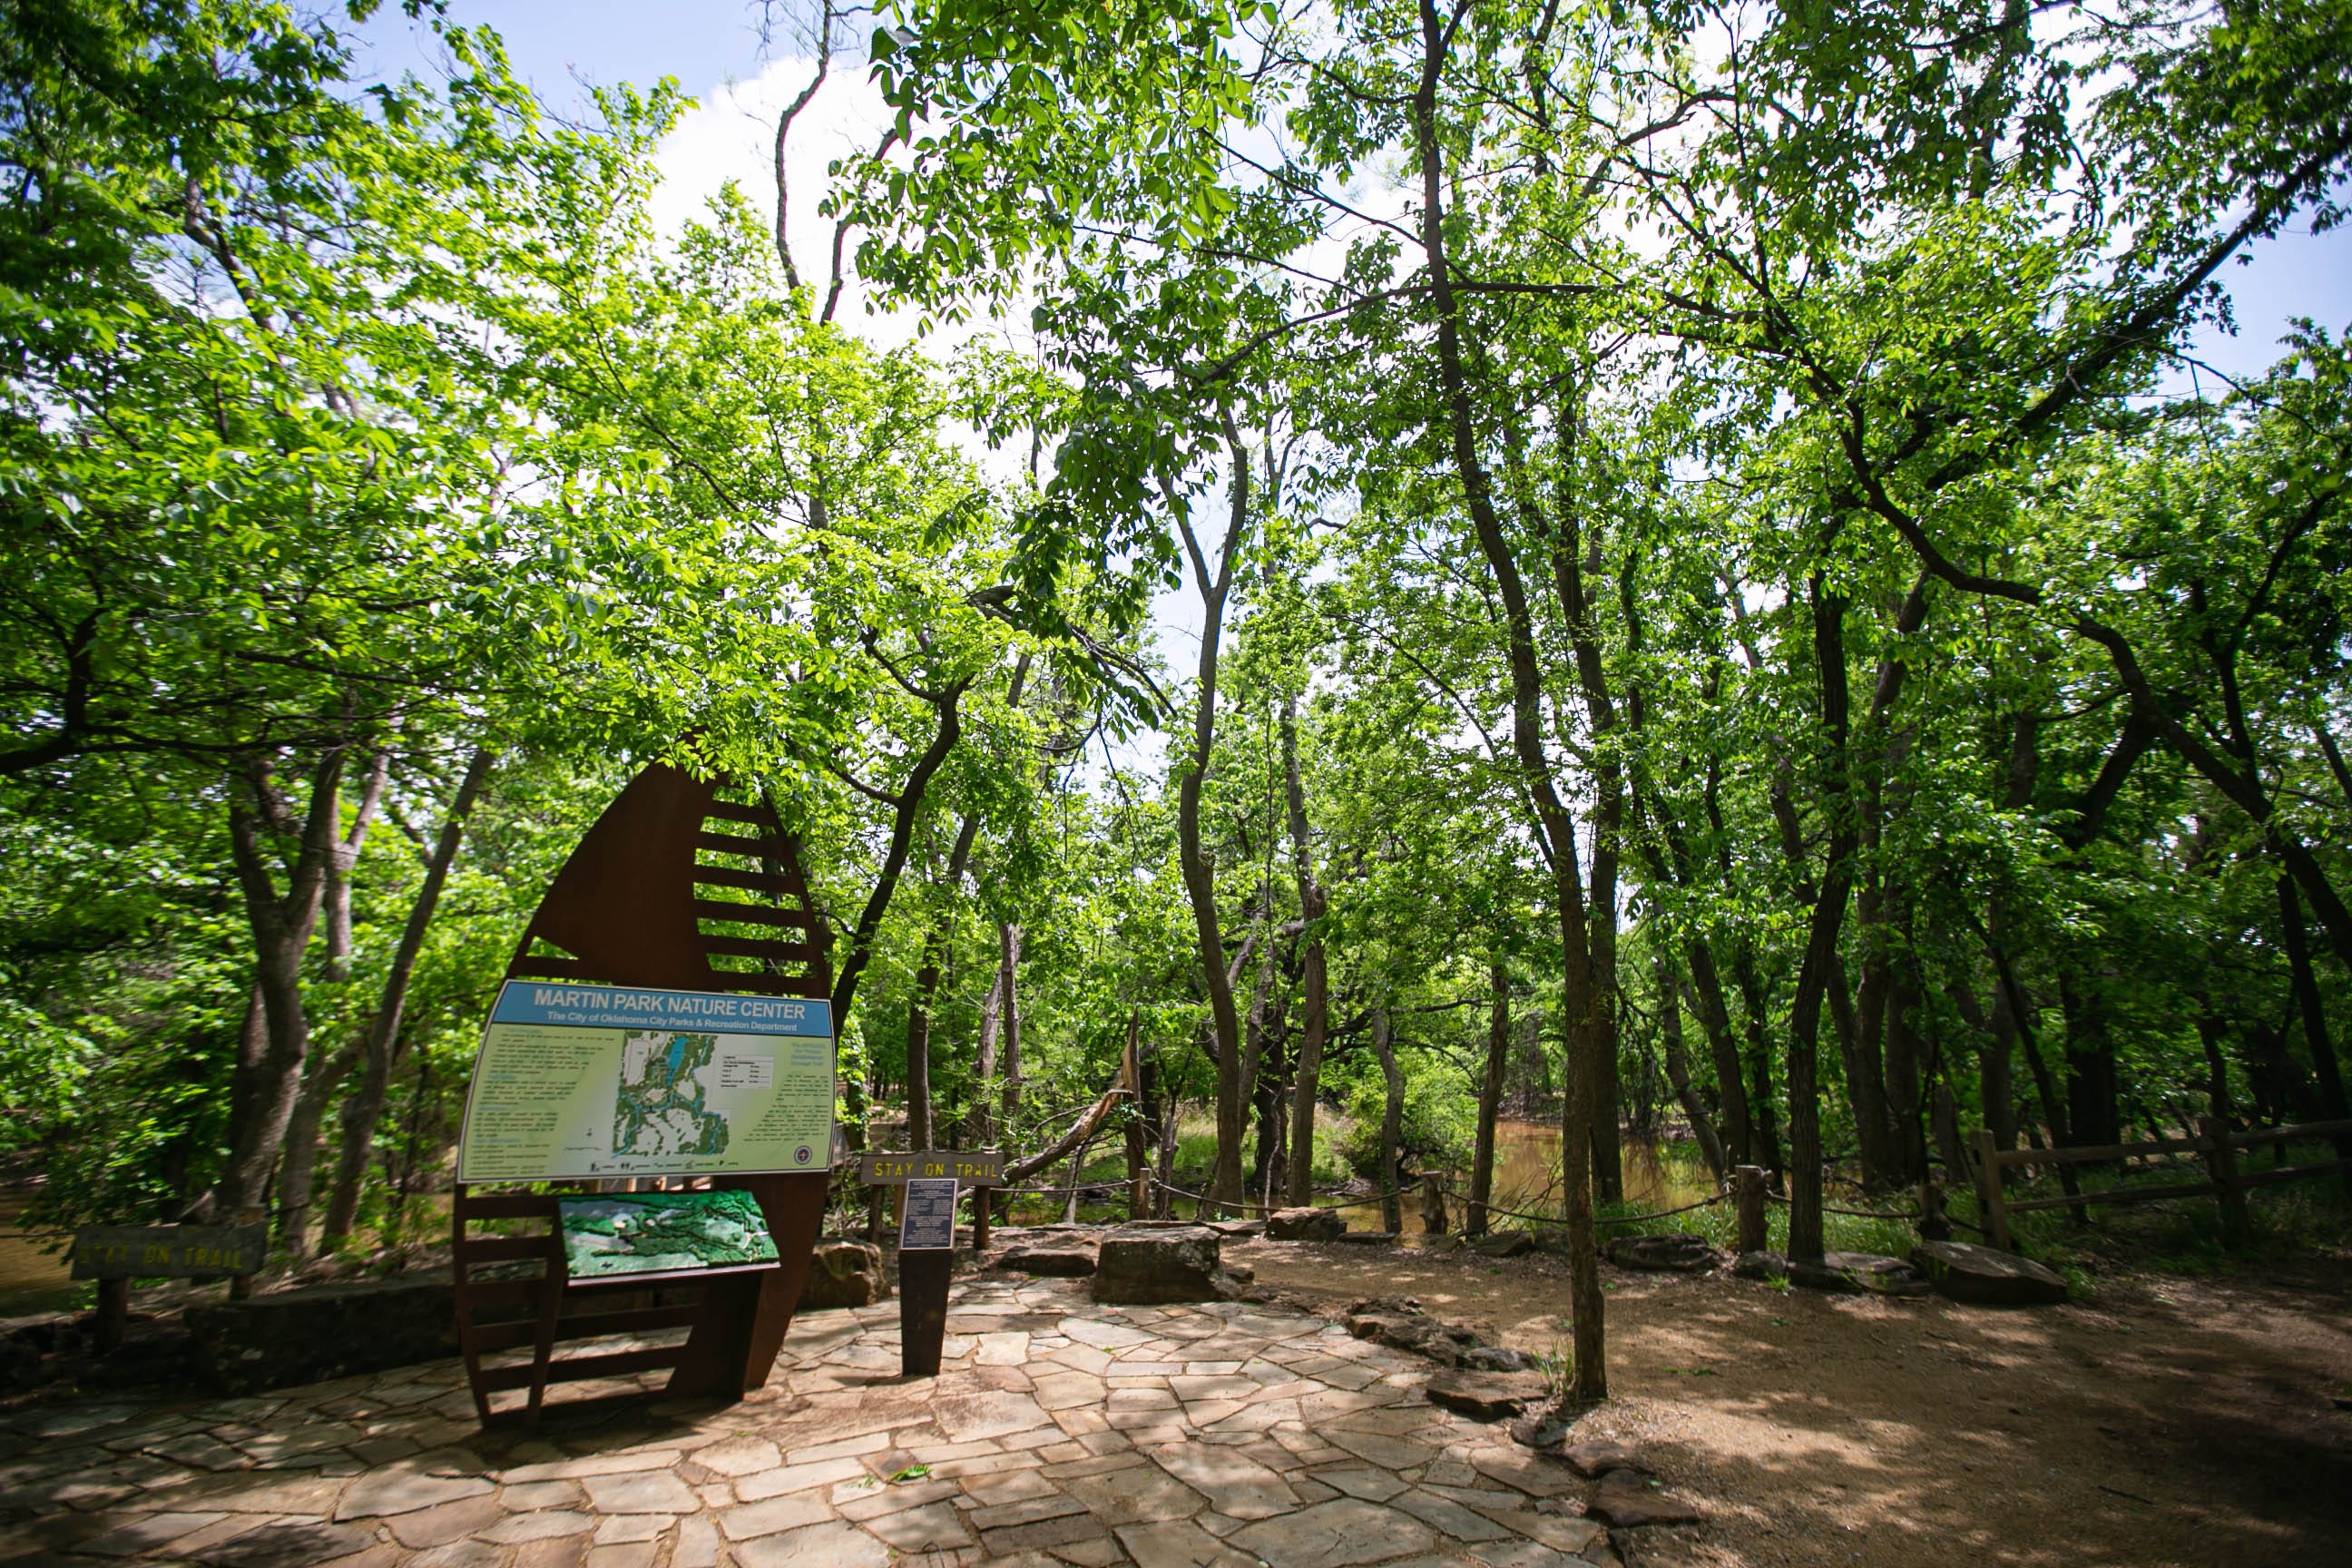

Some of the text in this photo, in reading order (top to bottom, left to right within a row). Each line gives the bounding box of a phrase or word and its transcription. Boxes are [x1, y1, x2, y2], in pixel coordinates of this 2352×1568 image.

[534, 988, 806, 1020] MARTIN PARK NATURE CENTER
[547, 1011, 798, 1032] The City of Oklahoma City Parks & Recreation Department
[874, 1161, 998, 1178] STAY ON TRAIL
[78, 1244, 243, 1269] STAY ON TRAIL
